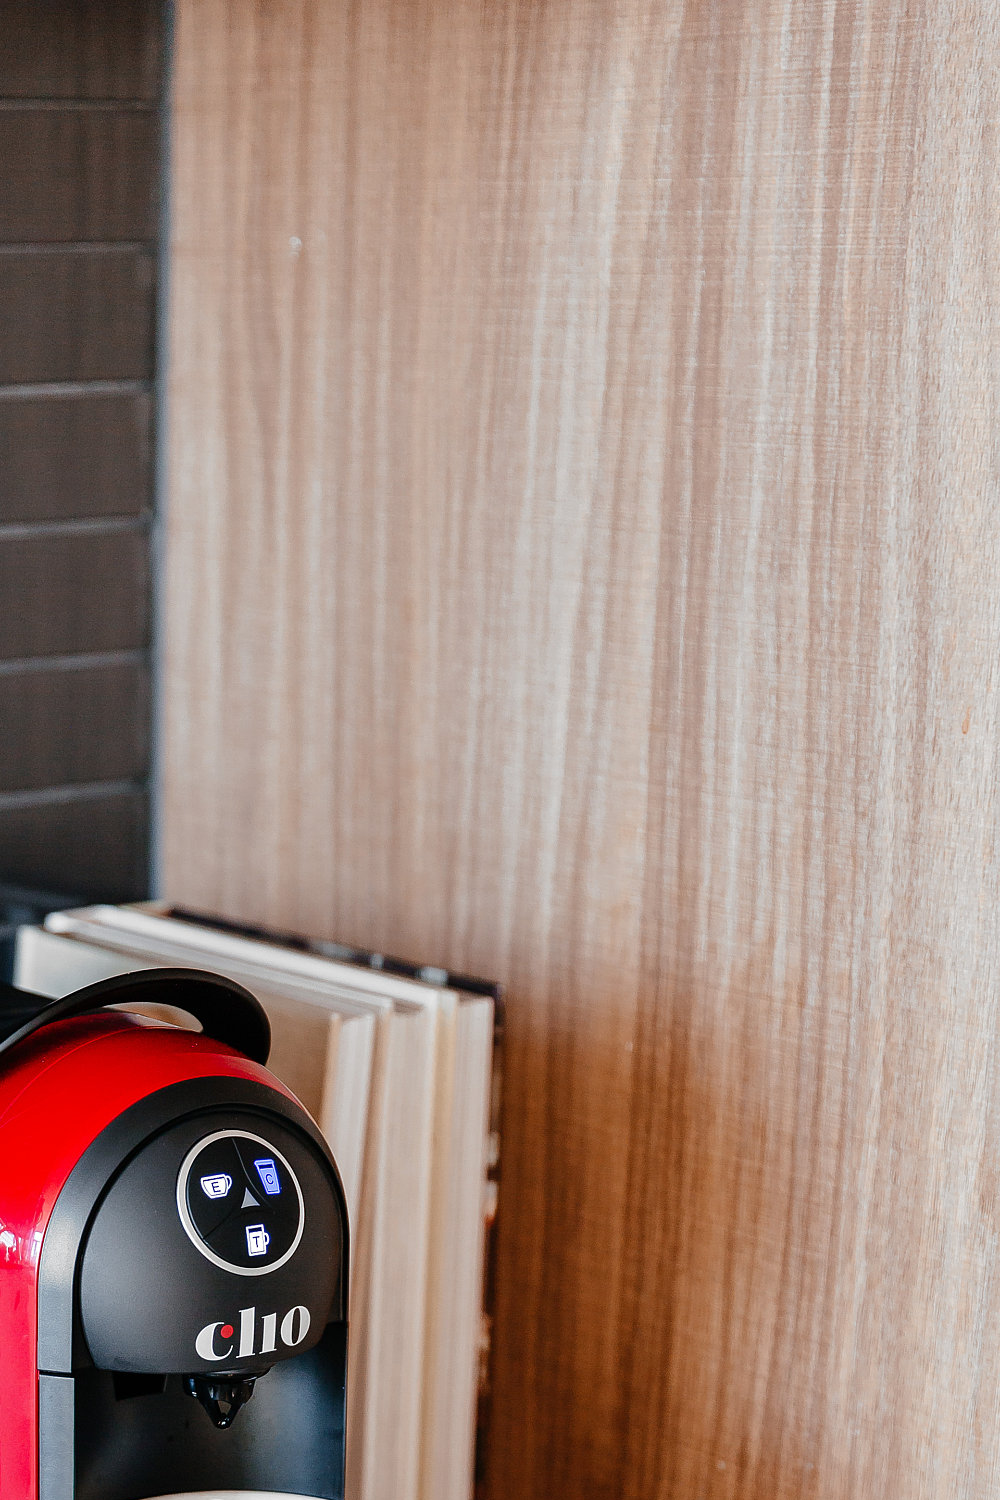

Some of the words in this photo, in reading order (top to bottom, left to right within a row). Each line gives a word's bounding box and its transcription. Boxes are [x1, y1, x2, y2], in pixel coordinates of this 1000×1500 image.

[264, 1173, 275, 1186] C
[210, 1181, 222, 1193] E
[251, 1235, 261, 1248] T
